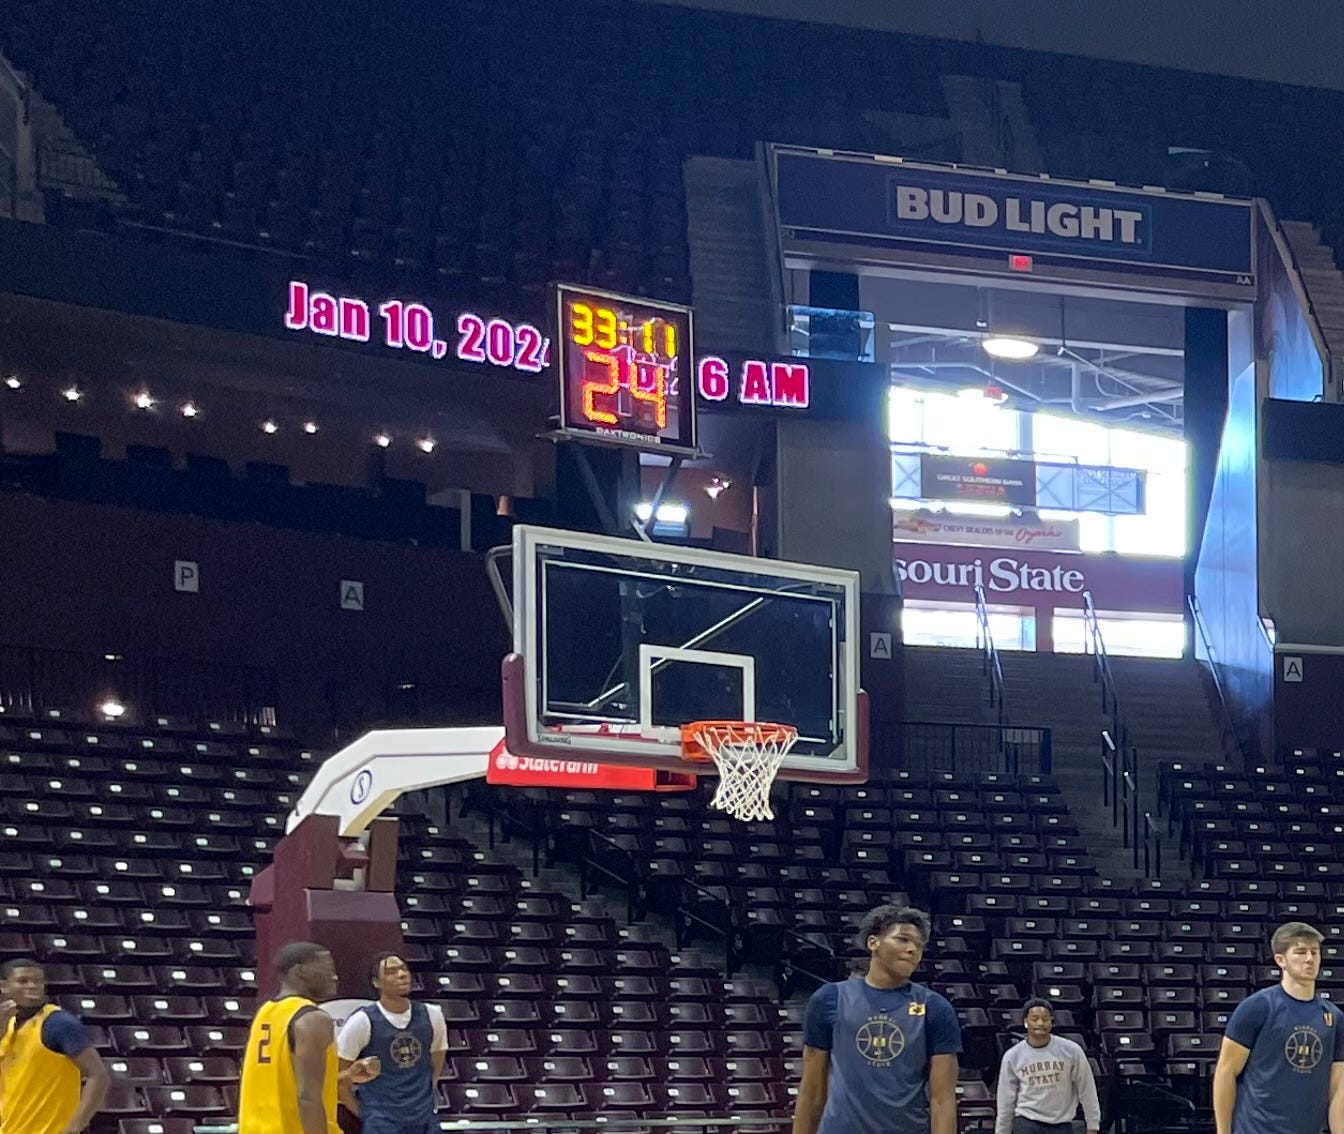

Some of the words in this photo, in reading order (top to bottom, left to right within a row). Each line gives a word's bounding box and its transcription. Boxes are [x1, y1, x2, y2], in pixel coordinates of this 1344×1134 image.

[896, 185, 998, 228] BUD
[1005, 198, 1142, 244] LIGHT
[284, 280, 370, 342] Jan
[378, 300, 447, 358] 10,
[456, 315, 550, 374] 202
[740, 360, 811, 408] AM
[570, 302, 677, 359] 33:11
[581, 350, 667, 429] 24
[181, 566, 194, 587] P
[989, 557, 1085, 593] State
[343, 585, 361, 606] A
[873, 637, 888, 656] A
[1286, 661, 1301, 677] A
[257, 1023, 272, 1065] 2
[1020, 1060, 1065, 1077] MURRAY
[1028, 1072, 1061, 1087] STATE
